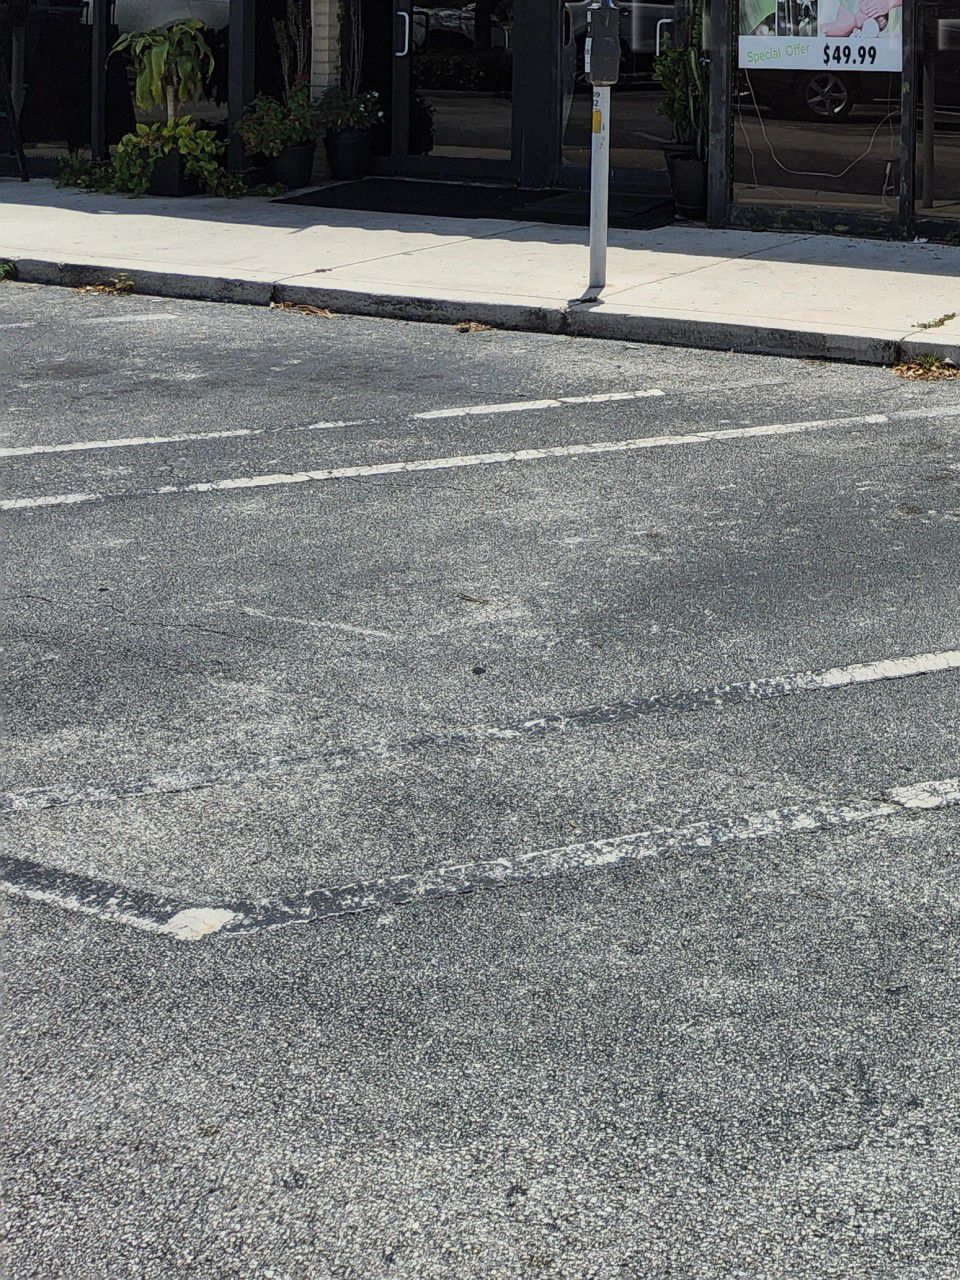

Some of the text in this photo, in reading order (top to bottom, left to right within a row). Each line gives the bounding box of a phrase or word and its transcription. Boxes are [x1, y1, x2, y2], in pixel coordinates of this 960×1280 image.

[747, 43, 877, 66] Special Offer $49.99
